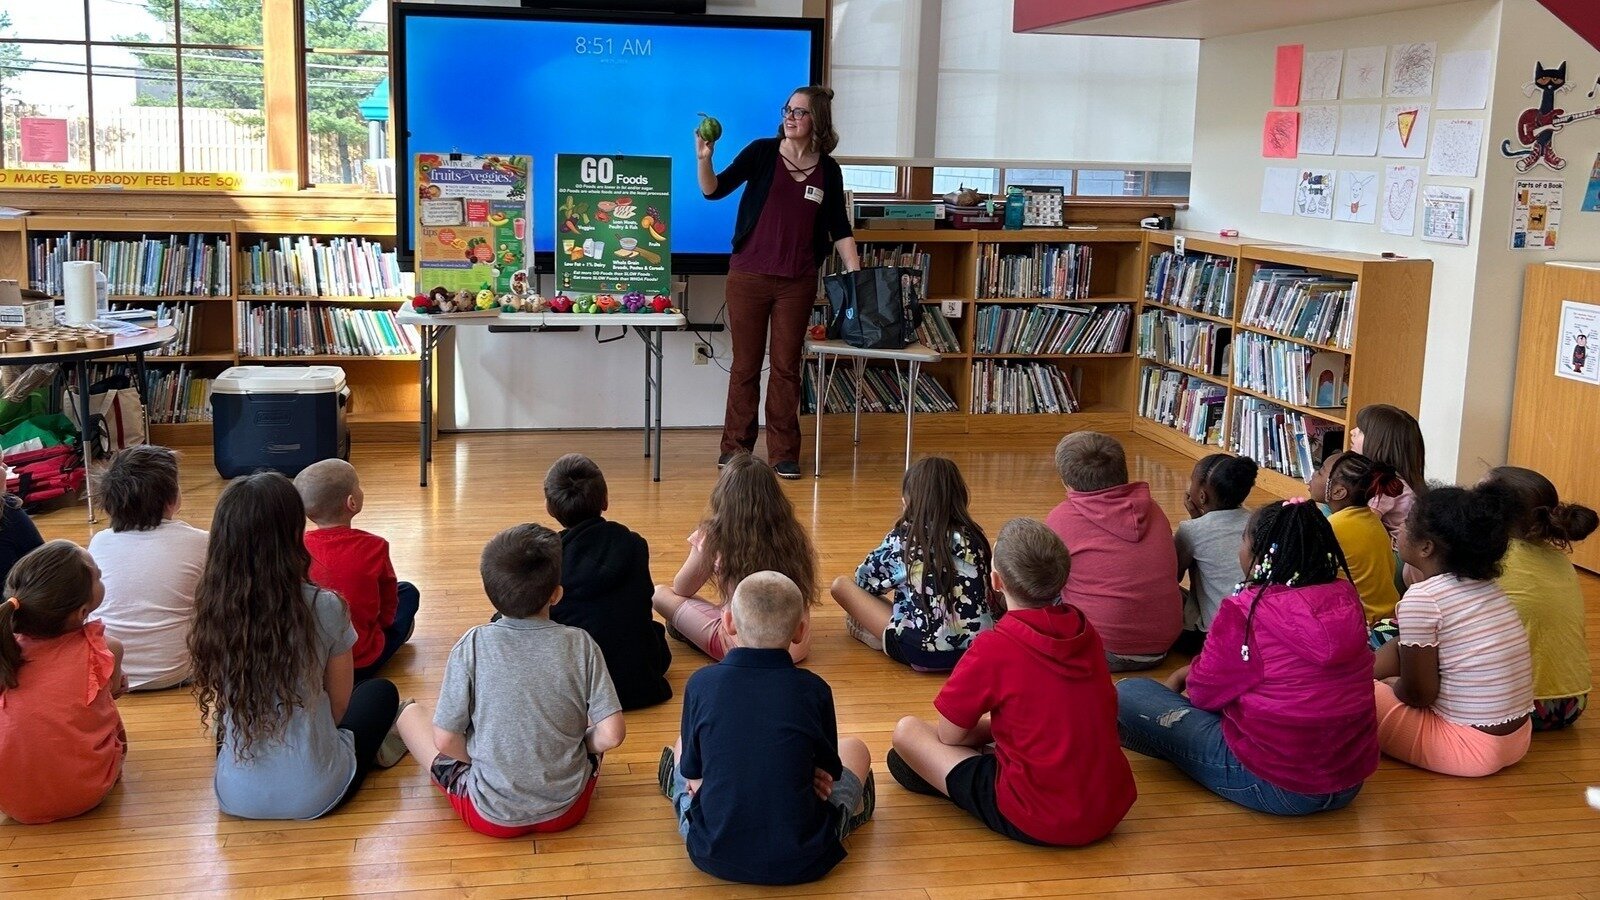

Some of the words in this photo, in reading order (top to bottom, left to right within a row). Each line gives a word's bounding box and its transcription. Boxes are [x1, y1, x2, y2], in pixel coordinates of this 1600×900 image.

[575, 36, 612, 54] 8:51
[621, 38, 652, 56] AM
[431, 170, 460, 180] fruits
[470, 172, 514, 184] veggies?
[581, 157, 614, 184] GO
[616, 174, 648, 184] Foods
[14, 174, 58, 184] MAKES
[64, 174, 139, 184] EVERYBODY
[145, 176, 175, 186] FEEL
[182, 176, 211, 186] LIKE
[423, 227, 438, 238] tips
